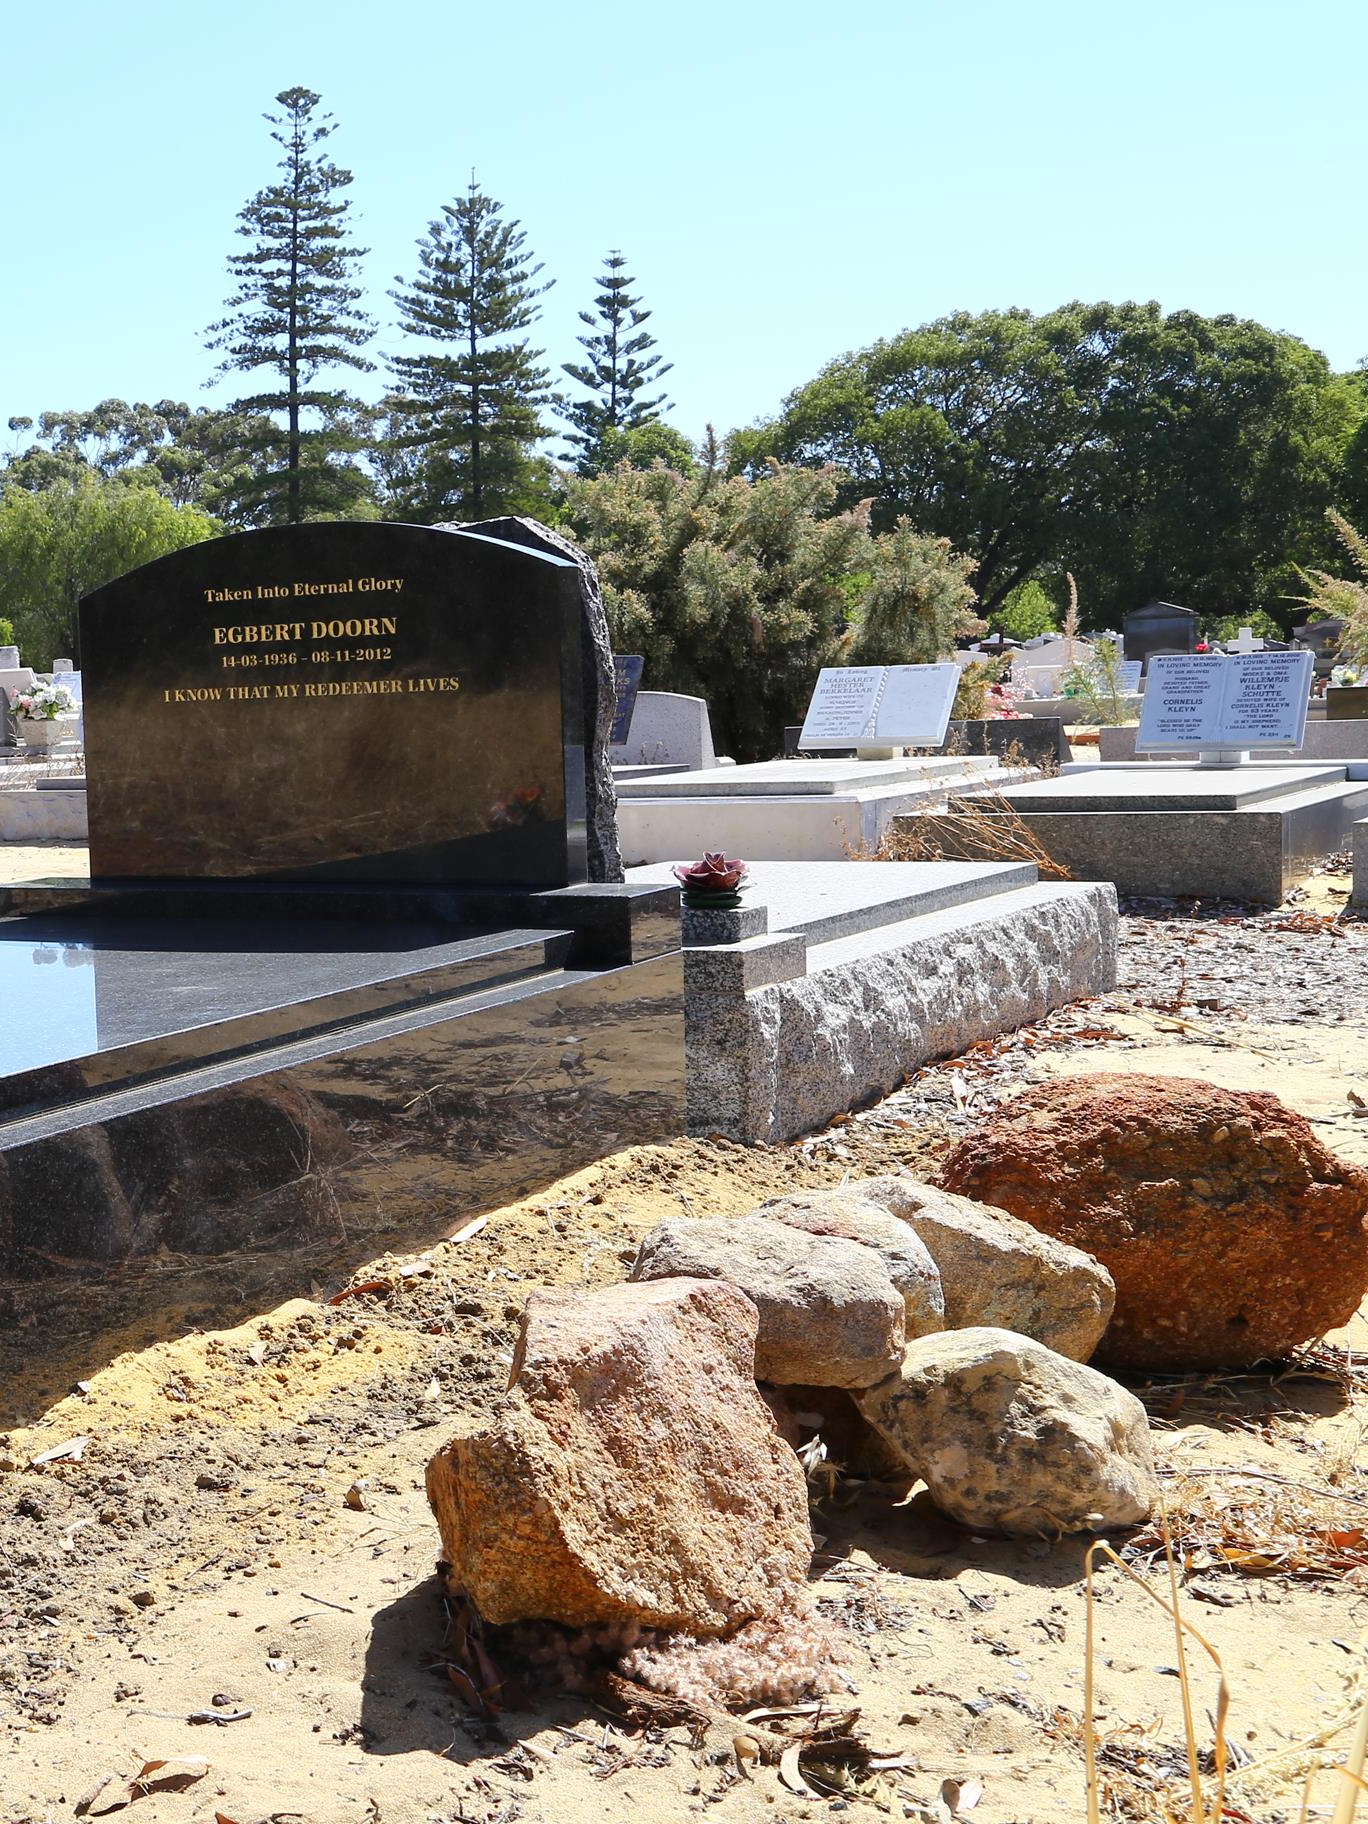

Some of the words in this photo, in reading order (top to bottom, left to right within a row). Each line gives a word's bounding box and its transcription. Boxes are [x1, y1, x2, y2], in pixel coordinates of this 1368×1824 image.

[204, 588, 252, 602] Taken
[257, 585, 289, 599] Into
[293, 579, 353, 597] Eternal
[357, 577, 404, 593] Glory
[213, 622, 305, 645] EGBERT
[311, 617, 397, 640] DOORN
[222, 652, 297, 668] 14-03-1936
[311, 647, 392, 664] 08-11-2012
[164, 689, 171, 703] I
[174, 687, 223, 702] KNOW
[227, 685, 270, 700] THAT
[275, 684, 301, 698] MY
[304, 679, 403, 697] REDEEMER
[407, 676, 460, 693] LIVES
[824, 676, 875, 684] MARGARET
